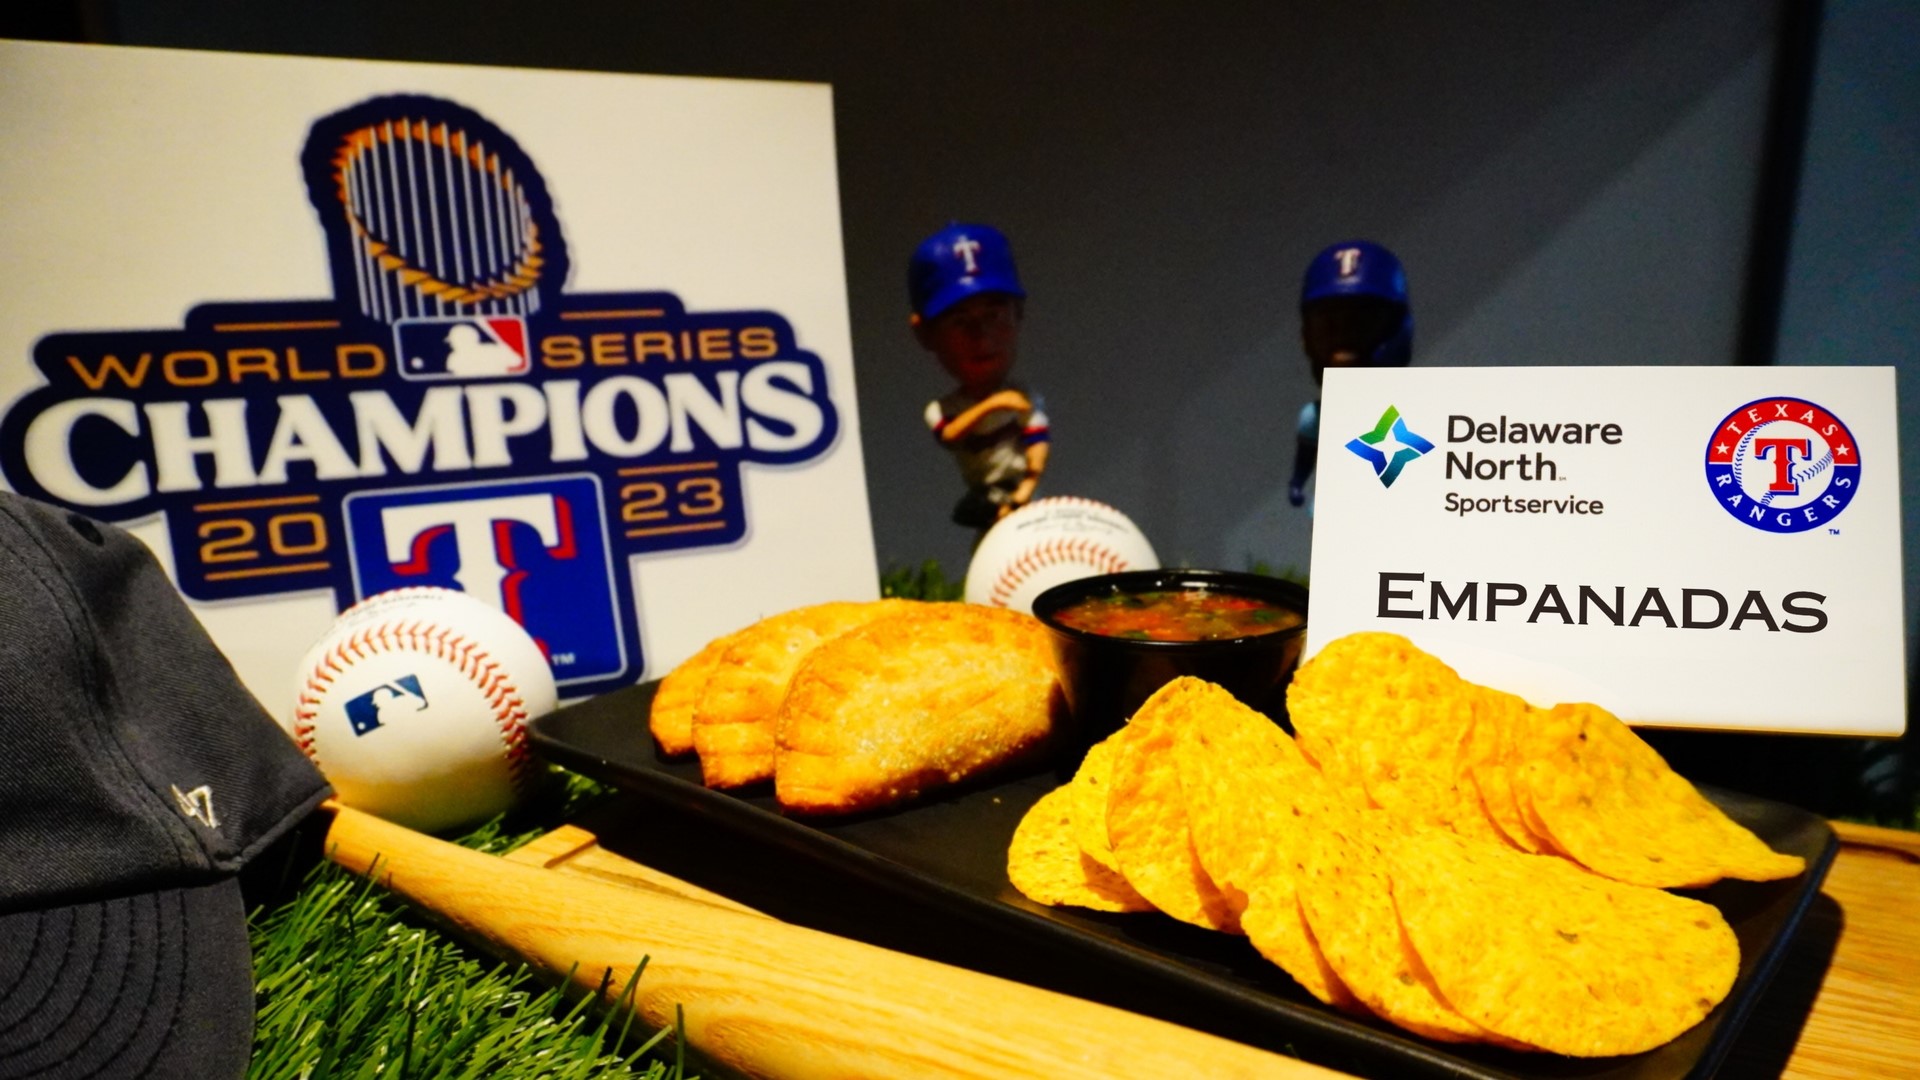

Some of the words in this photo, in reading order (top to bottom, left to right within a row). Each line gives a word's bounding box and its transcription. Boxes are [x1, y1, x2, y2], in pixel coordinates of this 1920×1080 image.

[953, 234, 982, 276] T
[66, 343, 387, 390] WORLD
[540, 327, 779, 367] SERIES
[23, 360, 824, 506] CHAMPIONS
[1447, 415, 1623, 445] Delaware
[1726, 403, 1839, 437] TEXAS
[1445, 451, 1557, 481] North
[1754, 437, 1812, 496] T
[198, 512, 329, 563] 20
[620, 477, 725, 522] 23
[1444, 492, 1604, 517] Sportservice
[1715, 472, 1852, 527] RANGERS
[381, 493, 577, 664] T
[1376, 572, 1829, 634] EMPANADAS
[551, 652, 576, 666] TM
